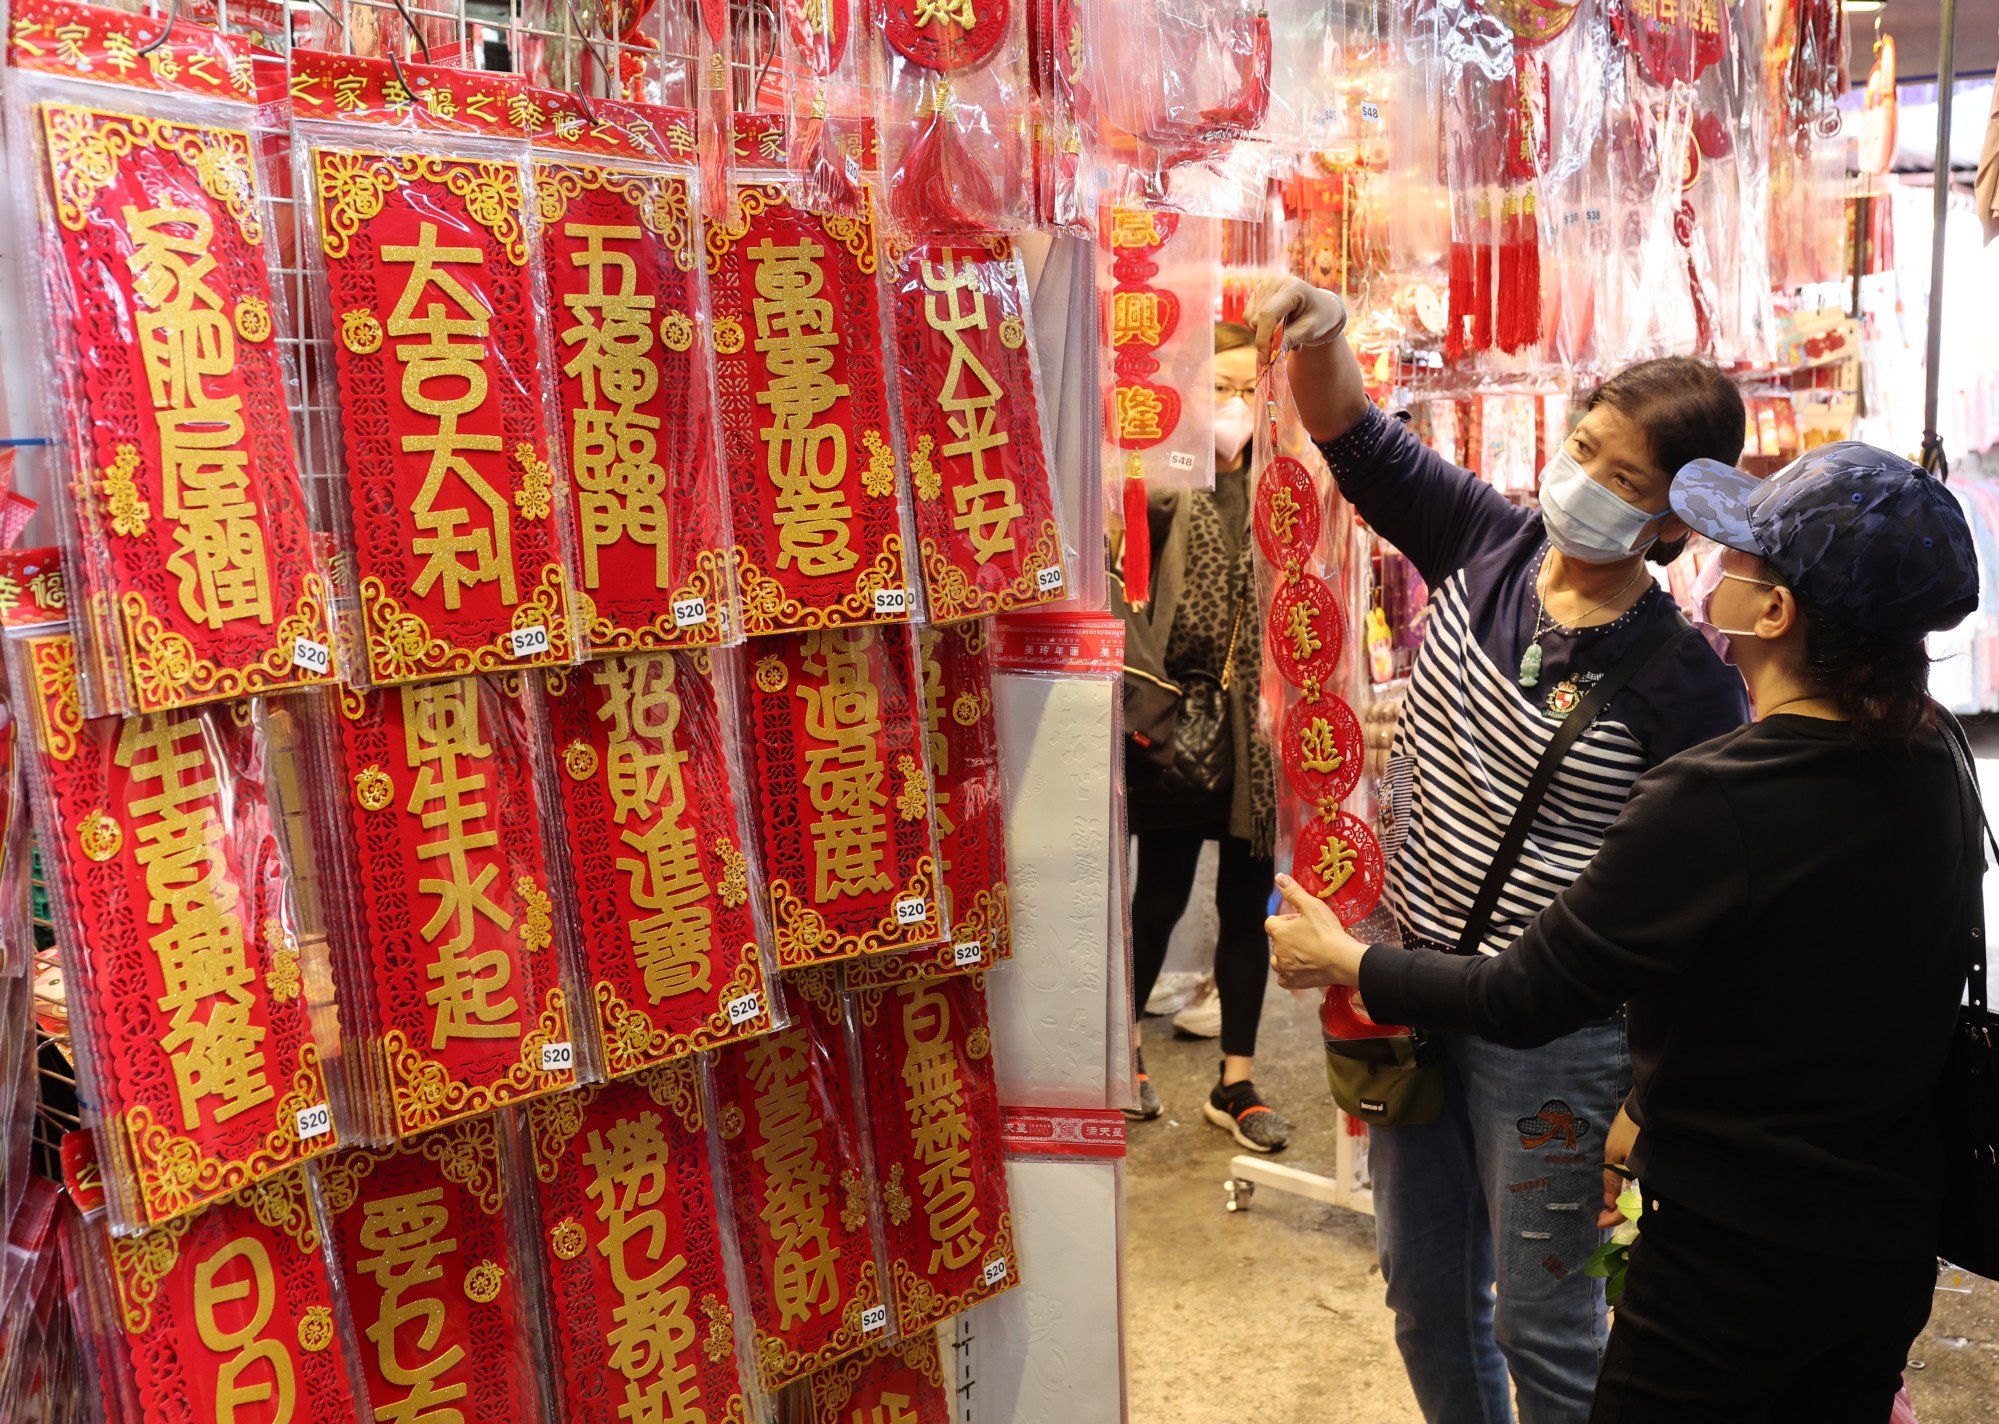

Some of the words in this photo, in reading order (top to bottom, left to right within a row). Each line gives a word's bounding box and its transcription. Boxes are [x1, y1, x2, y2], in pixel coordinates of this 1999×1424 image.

[1362, 106, 1378, 118] $48
[1587, 211, 1600, 221] $38
[380, 221, 518, 610] 大吉大利
[561, 222, 669, 589] 五福臨門
[746, 237, 860, 577] 萬事如意
[921, 246, 1024, 566] 出入平安
[121, 204, 274, 630] 家肥屋潤
[1171, 454, 1193, 468] $48
[1039, 571, 1061, 585] $20
[876, 593, 904, 607] $20
[676, 604, 703, 620] $20
[515, 631, 545, 648] $20
[296, 645, 326, 665] $20
[1268, 486, 1358, 899] 學業進步
[593, 651, 713, 1006] 招財進寶
[401, 677, 521, 1050] 風生水起
[898, 902, 924, 918] $20
[114, 714, 277, 1132] 生意興隆
[956, 945, 980, 960] $20
[731, 998, 757, 1018] $20
[543, 1048, 571, 1063] $20
[300, 1110, 328, 1131] $20
[897, 977, 987, 1275] 百無禁忌
[744, 1014, 841, 1332] 恭喜發財
[985, 1261, 1005, 1281] $20
[863, 1310, 885, 1327] $20
